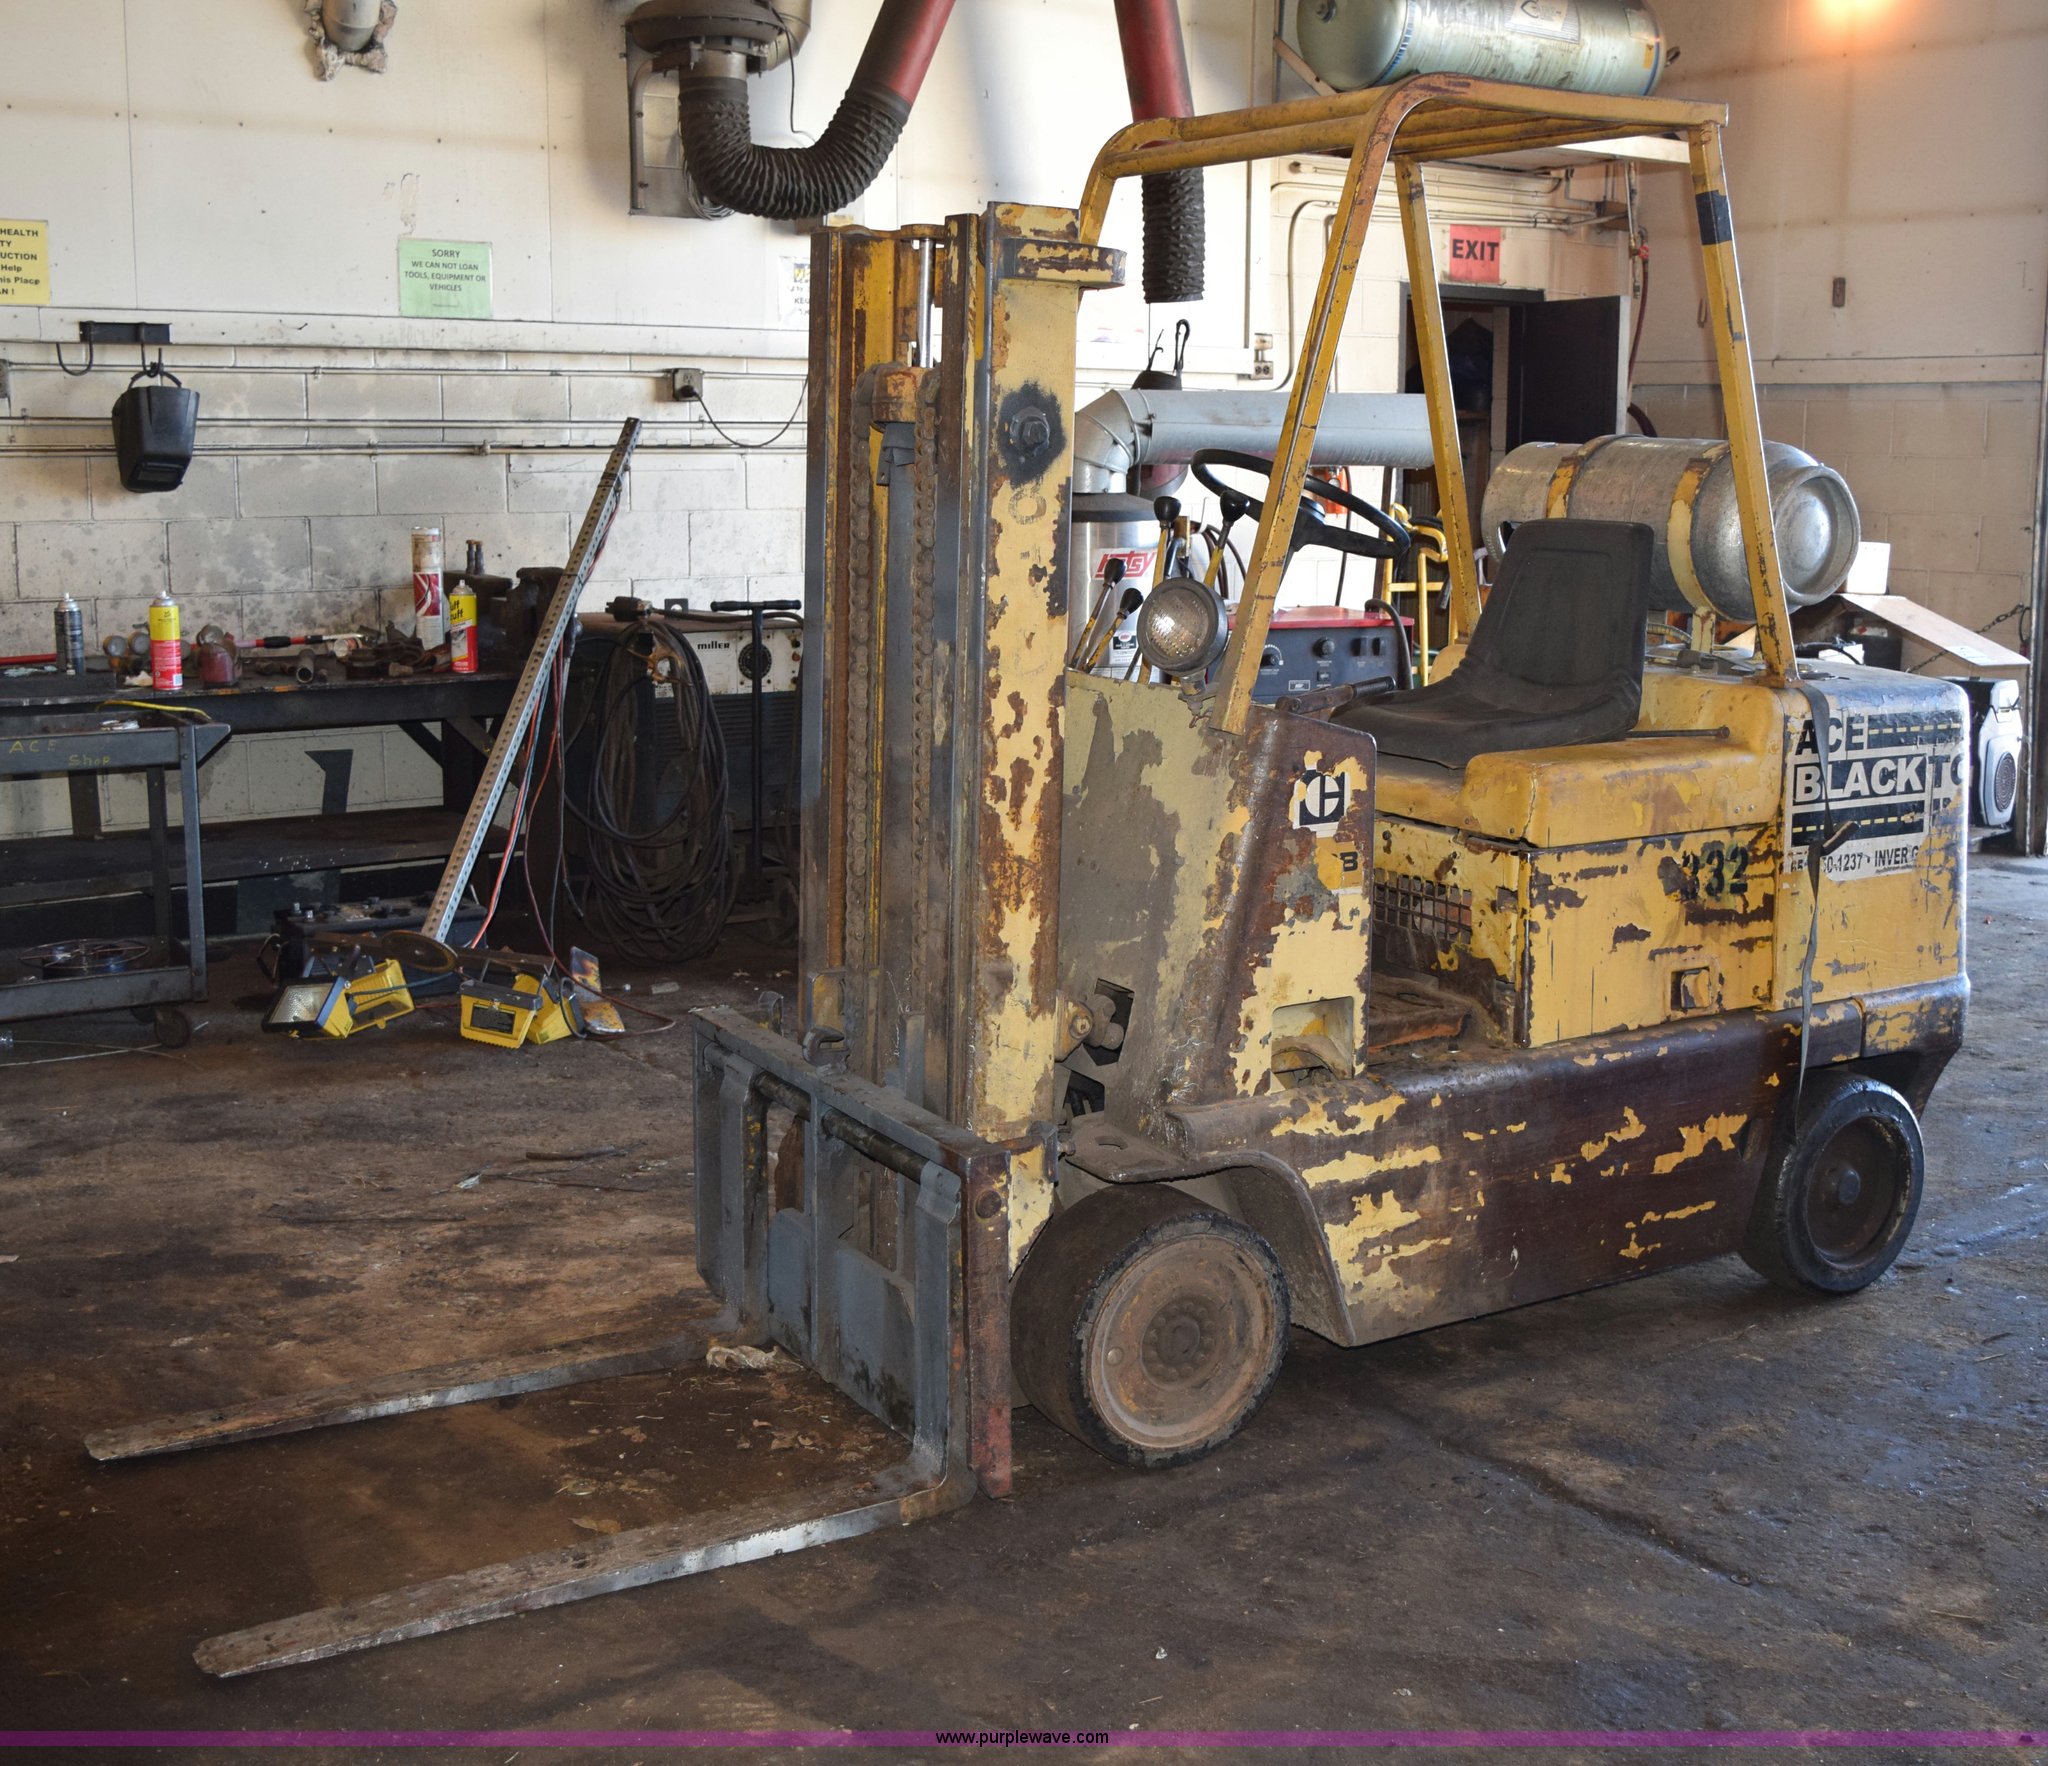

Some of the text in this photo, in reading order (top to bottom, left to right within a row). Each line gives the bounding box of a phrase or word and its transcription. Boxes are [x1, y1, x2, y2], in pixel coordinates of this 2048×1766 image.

[0, 229, 38, 237] HEALTH
[432, 249, 460, 258] SORRY
[1452, 238, 1499, 261] EXIT
[0, 264, 22, 273] Help
[412, 260, 479, 271] WE CAN NOT LOAN
[431, 272, 474, 282] EQUIPMENT
[475, 274, 486, 282] OR
[429, 283, 462, 292] VEHICLES
[1795, 713, 1865, 755] ACE
[9, 739, 57, 754] ACE
[1795, 757, 1923, 804] BLACK
[1340, 851, 1358, 872] B
[1874, 847, 1908, 867] INVER
